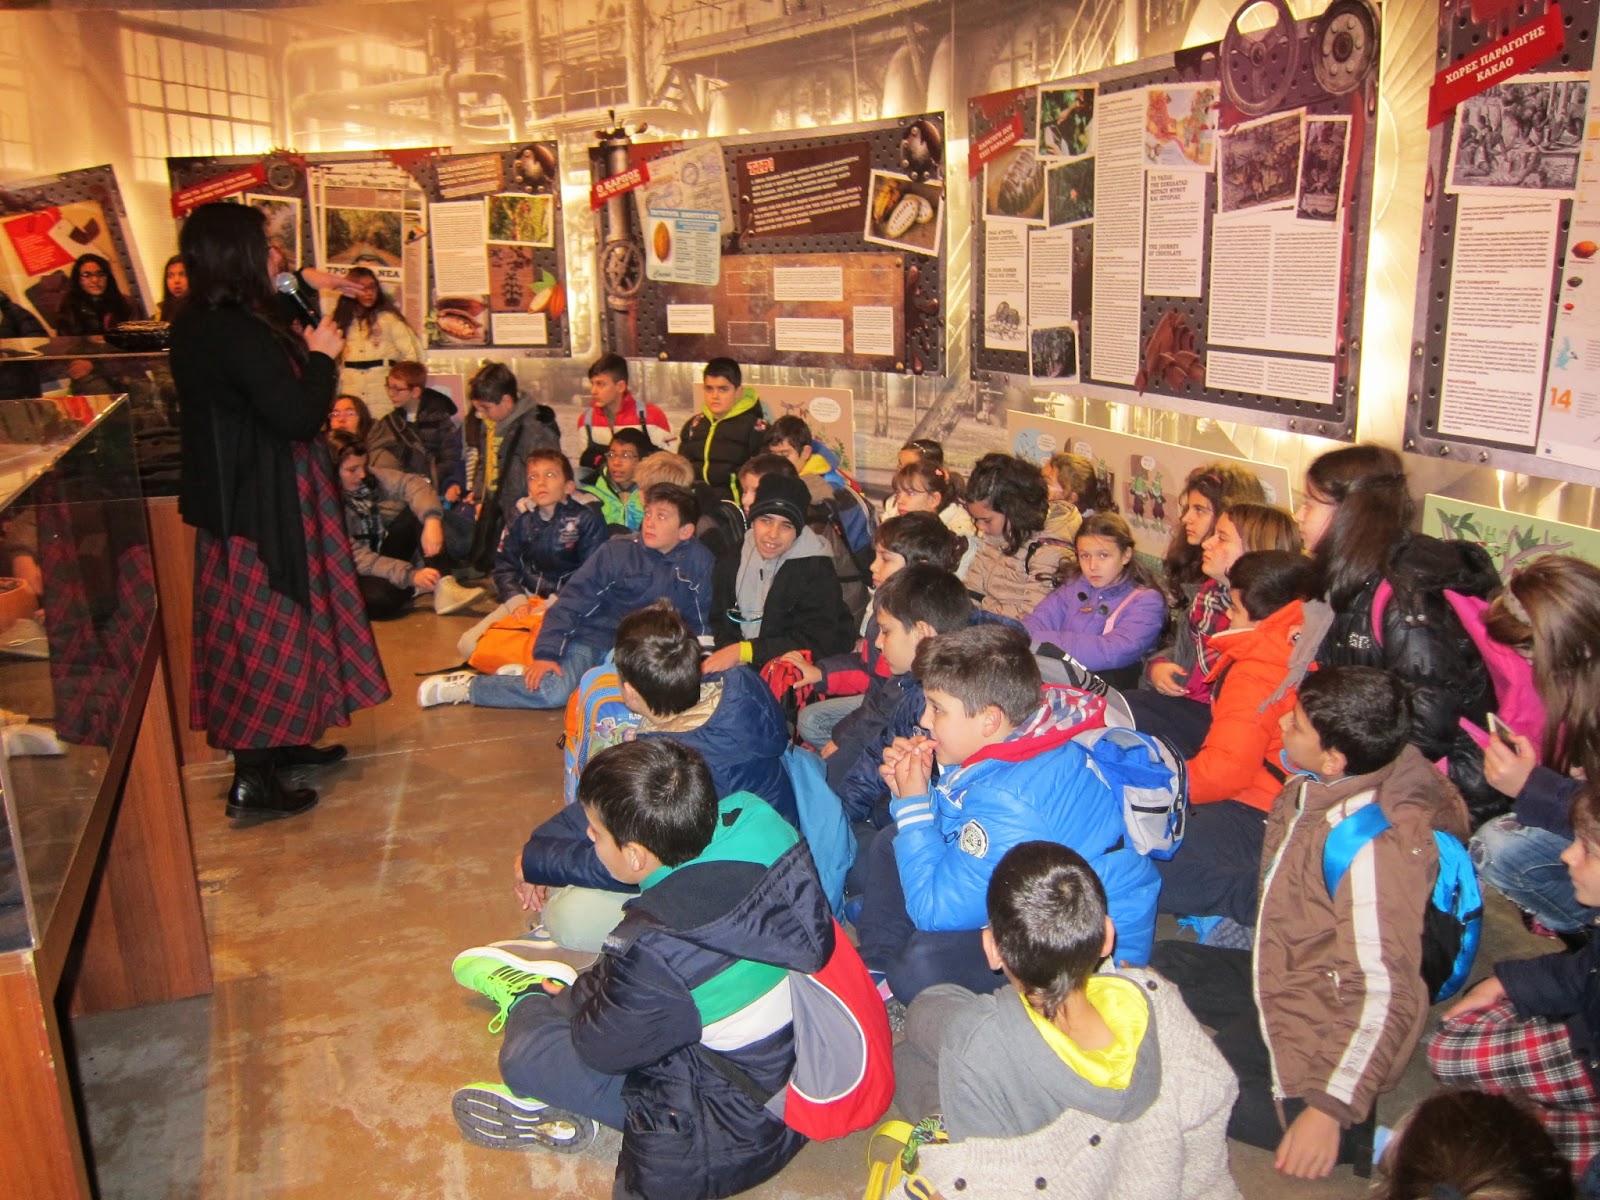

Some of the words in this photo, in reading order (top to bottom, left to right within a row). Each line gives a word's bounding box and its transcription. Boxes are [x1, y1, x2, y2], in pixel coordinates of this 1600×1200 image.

[1445, 60, 1479, 84] ΧΩΡΕΣ
[1480, 25, 1546, 67] ΠΑΡΑΓΩΓΗΣ
[1476, 57, 1515, 82] ΚΑΚΑΟ
[1551, 387, 1572, 409] 14
